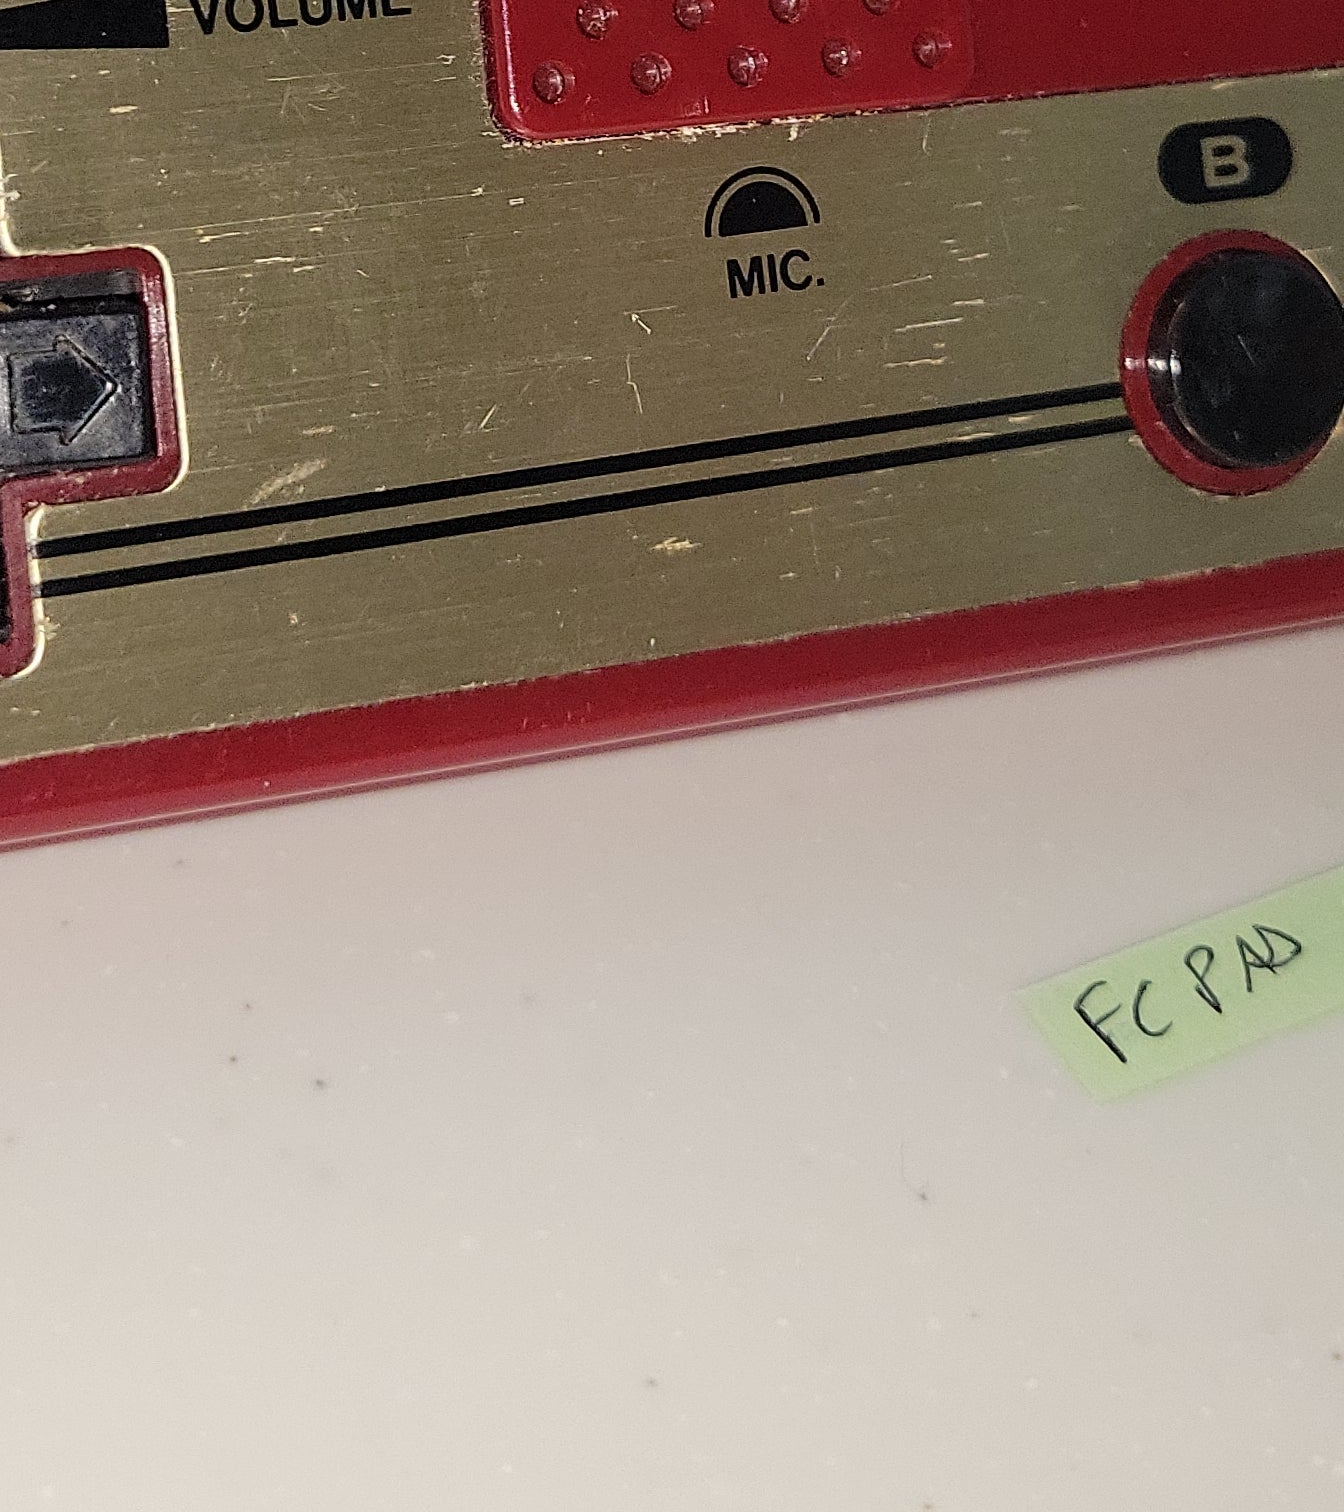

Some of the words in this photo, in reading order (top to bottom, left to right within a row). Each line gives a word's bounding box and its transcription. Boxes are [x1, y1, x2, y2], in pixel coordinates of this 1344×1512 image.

[1201, 133, 1253, 190] B
[726, 248, 826, 300] MIC.
[1073, 979, 1173, 1064] FC
[1183, 922, 1303, 1014] PAD
